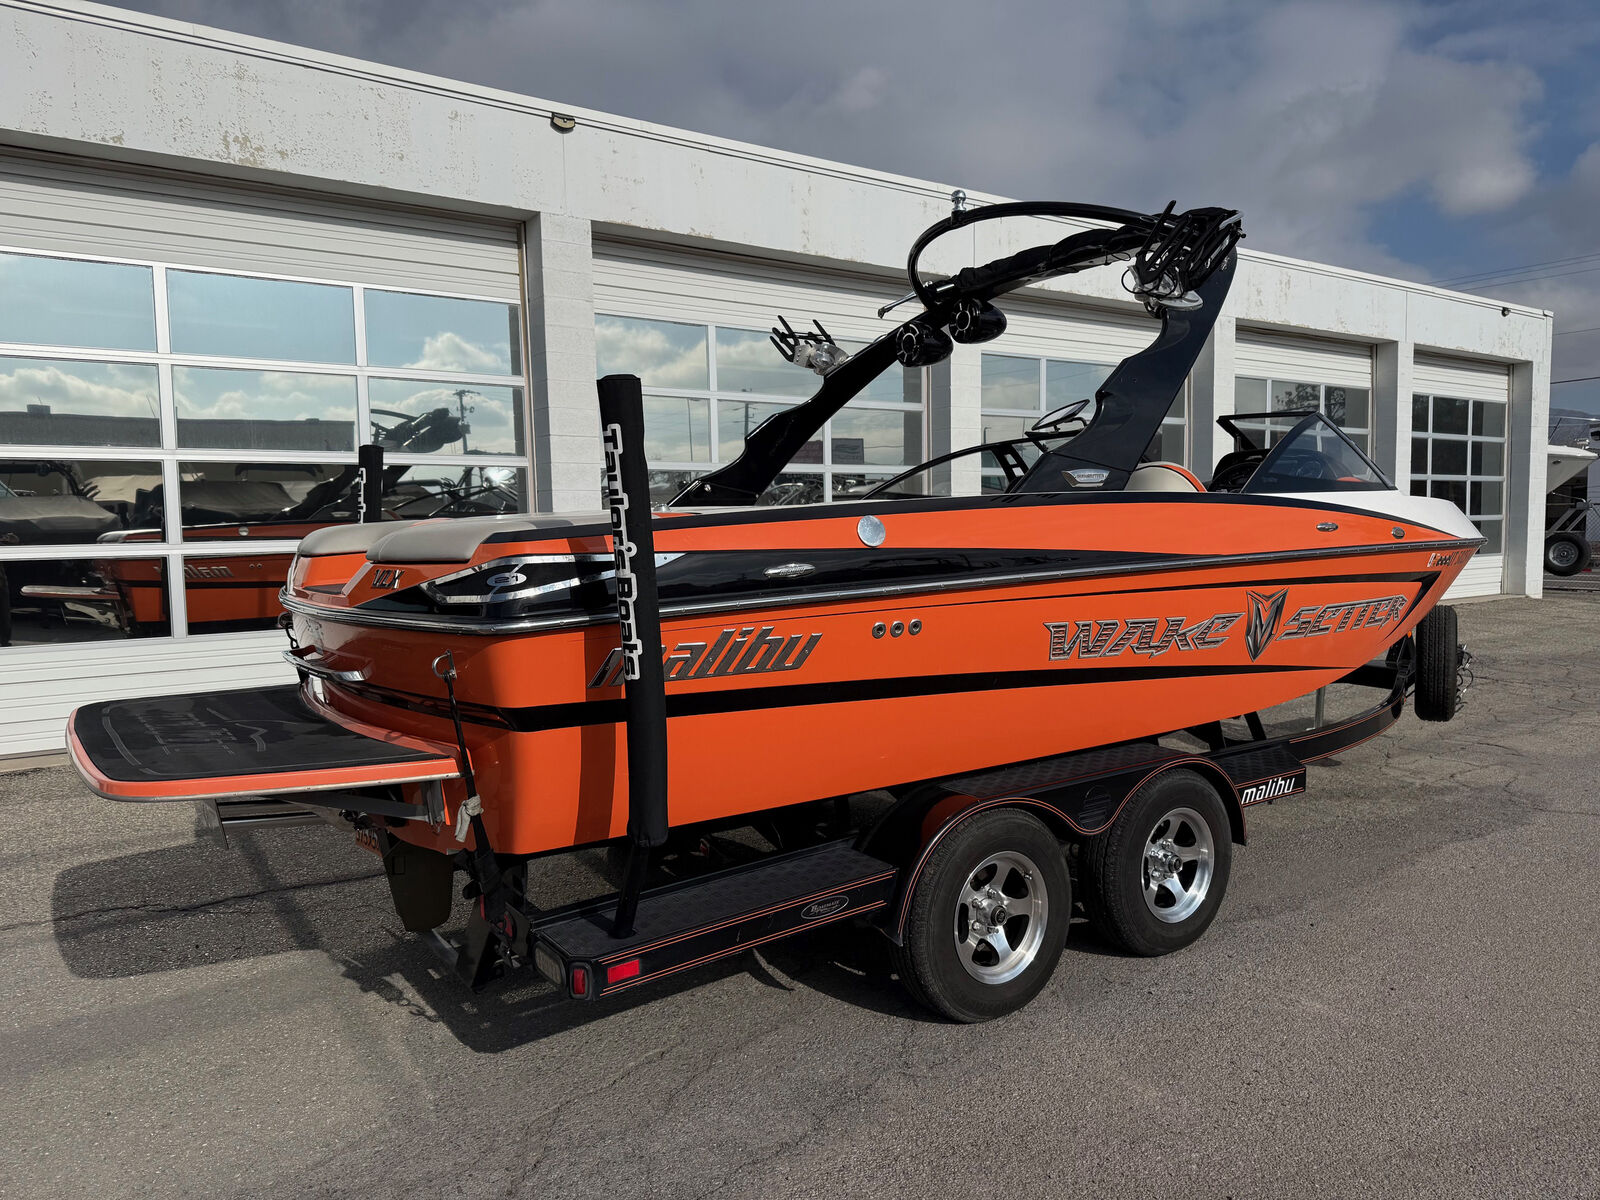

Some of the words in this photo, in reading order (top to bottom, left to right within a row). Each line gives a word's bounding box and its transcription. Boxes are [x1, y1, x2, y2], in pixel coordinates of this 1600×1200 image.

[616, 573, 643, 680] Boats
[1043, 612, 1246, 661] WAKE
[1275, 594, 1409, 642] SETTER
[1240, 776, 1295, 805] malibu
